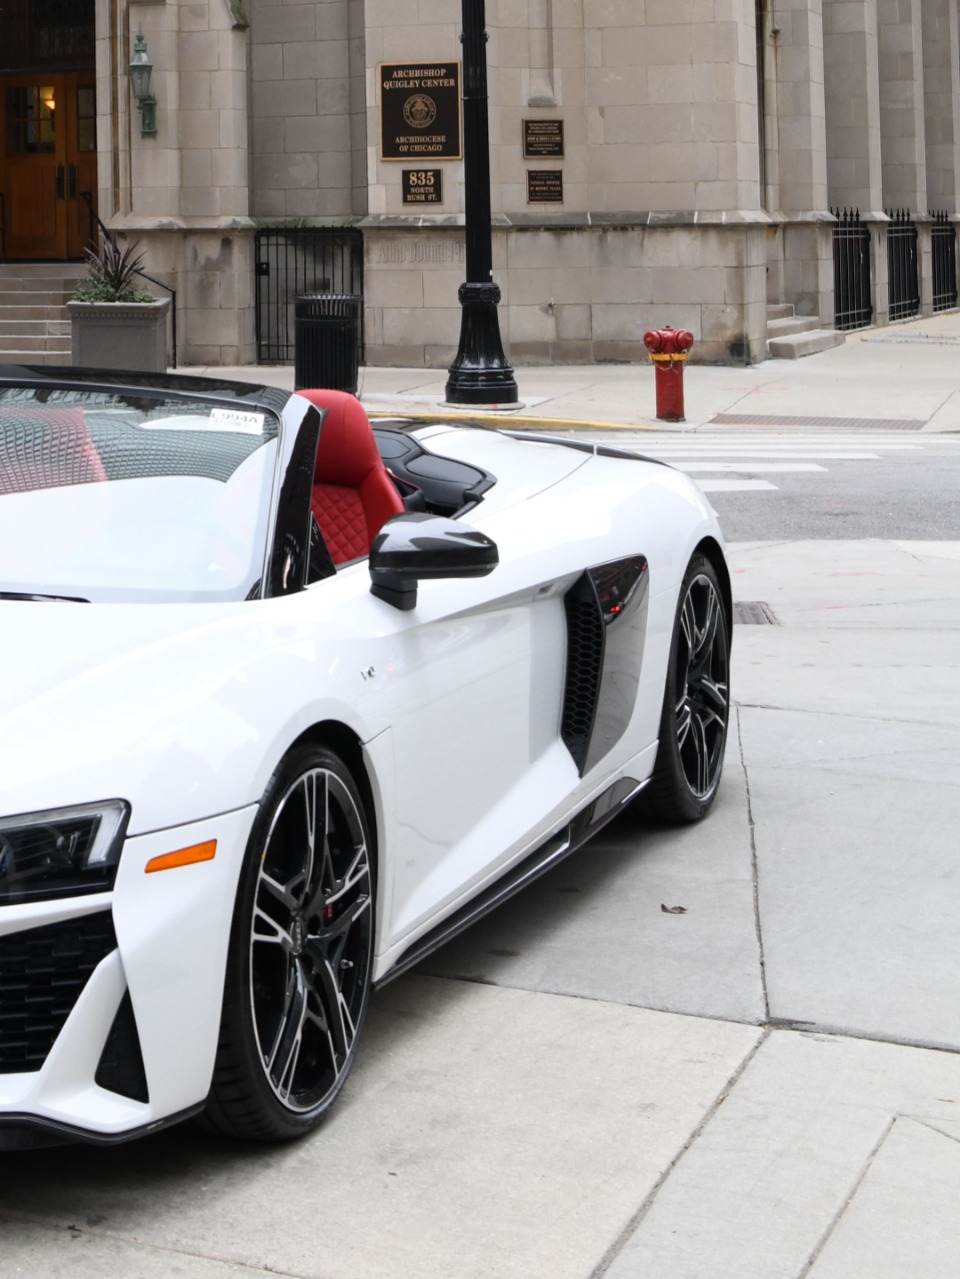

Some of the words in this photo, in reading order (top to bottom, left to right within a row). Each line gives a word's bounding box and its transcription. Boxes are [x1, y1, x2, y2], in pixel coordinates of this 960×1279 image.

[392, 68, 446, 78] ARCHBISHOP
[383, 80, 420, 90] QUIGLEY
[421, 78, 456, 88] CENTER
[394, 135, 446, 143] ARCHDIOCESE
[410, 144, 442, 152] CHICAGO
[409, 171, 435, 186] 835
[410, 186, 434, 194] NORTH
